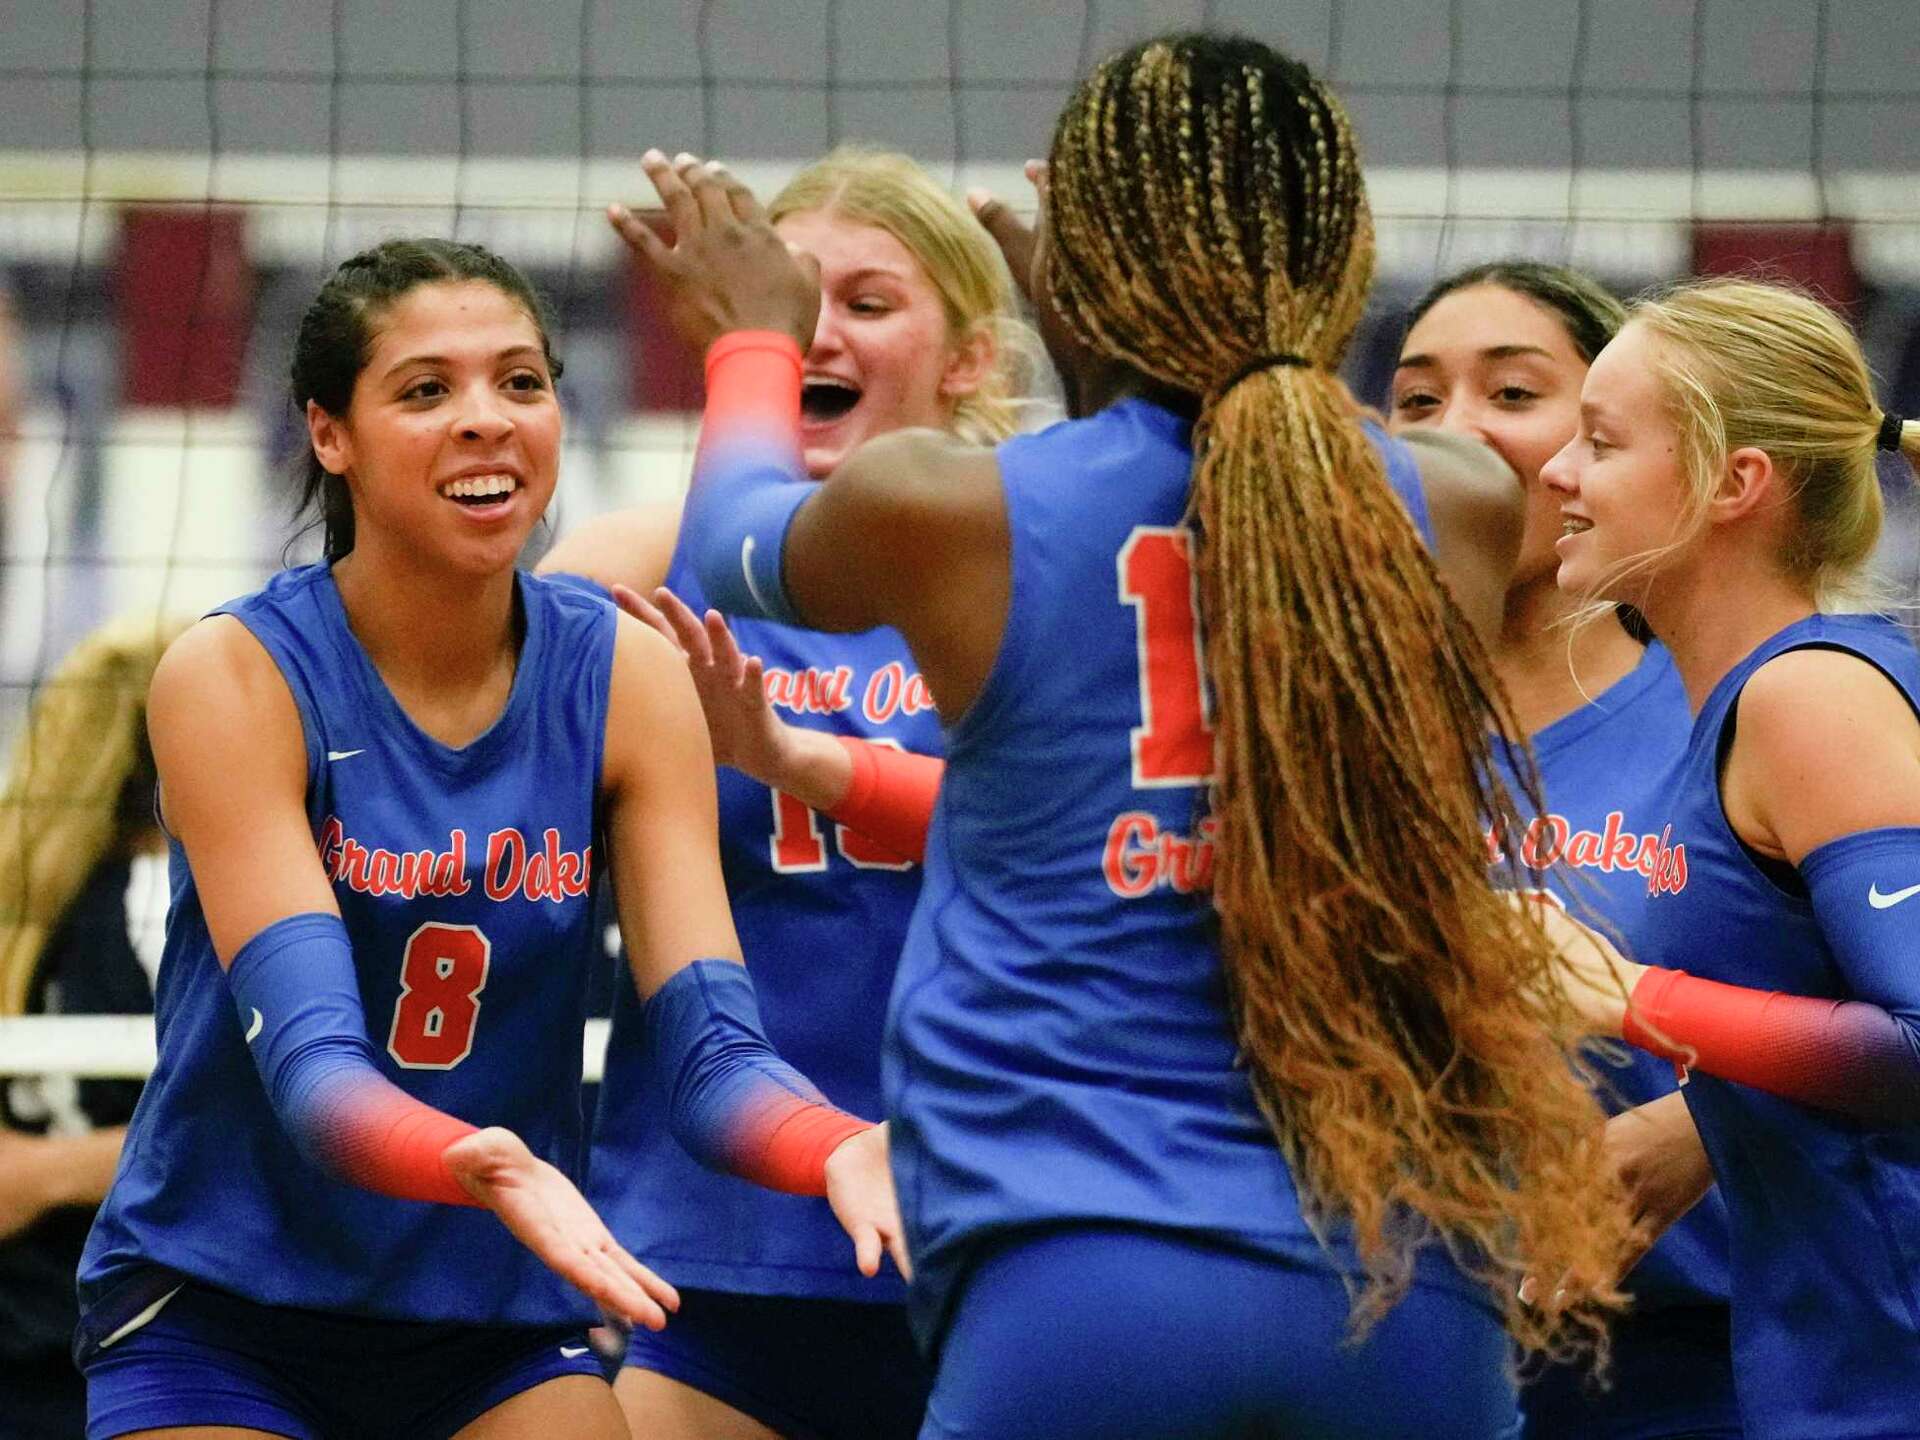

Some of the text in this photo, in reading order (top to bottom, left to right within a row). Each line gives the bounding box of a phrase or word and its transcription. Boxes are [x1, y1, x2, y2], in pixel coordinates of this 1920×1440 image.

[762, 660, 936, 723] and Oa
[319, 814, 471, 899] Grand
[1101, 811, 1217, 898] Gri
[1520, 811, 1658, 876] Oaks
[387, 921, 491, 1070] 8
